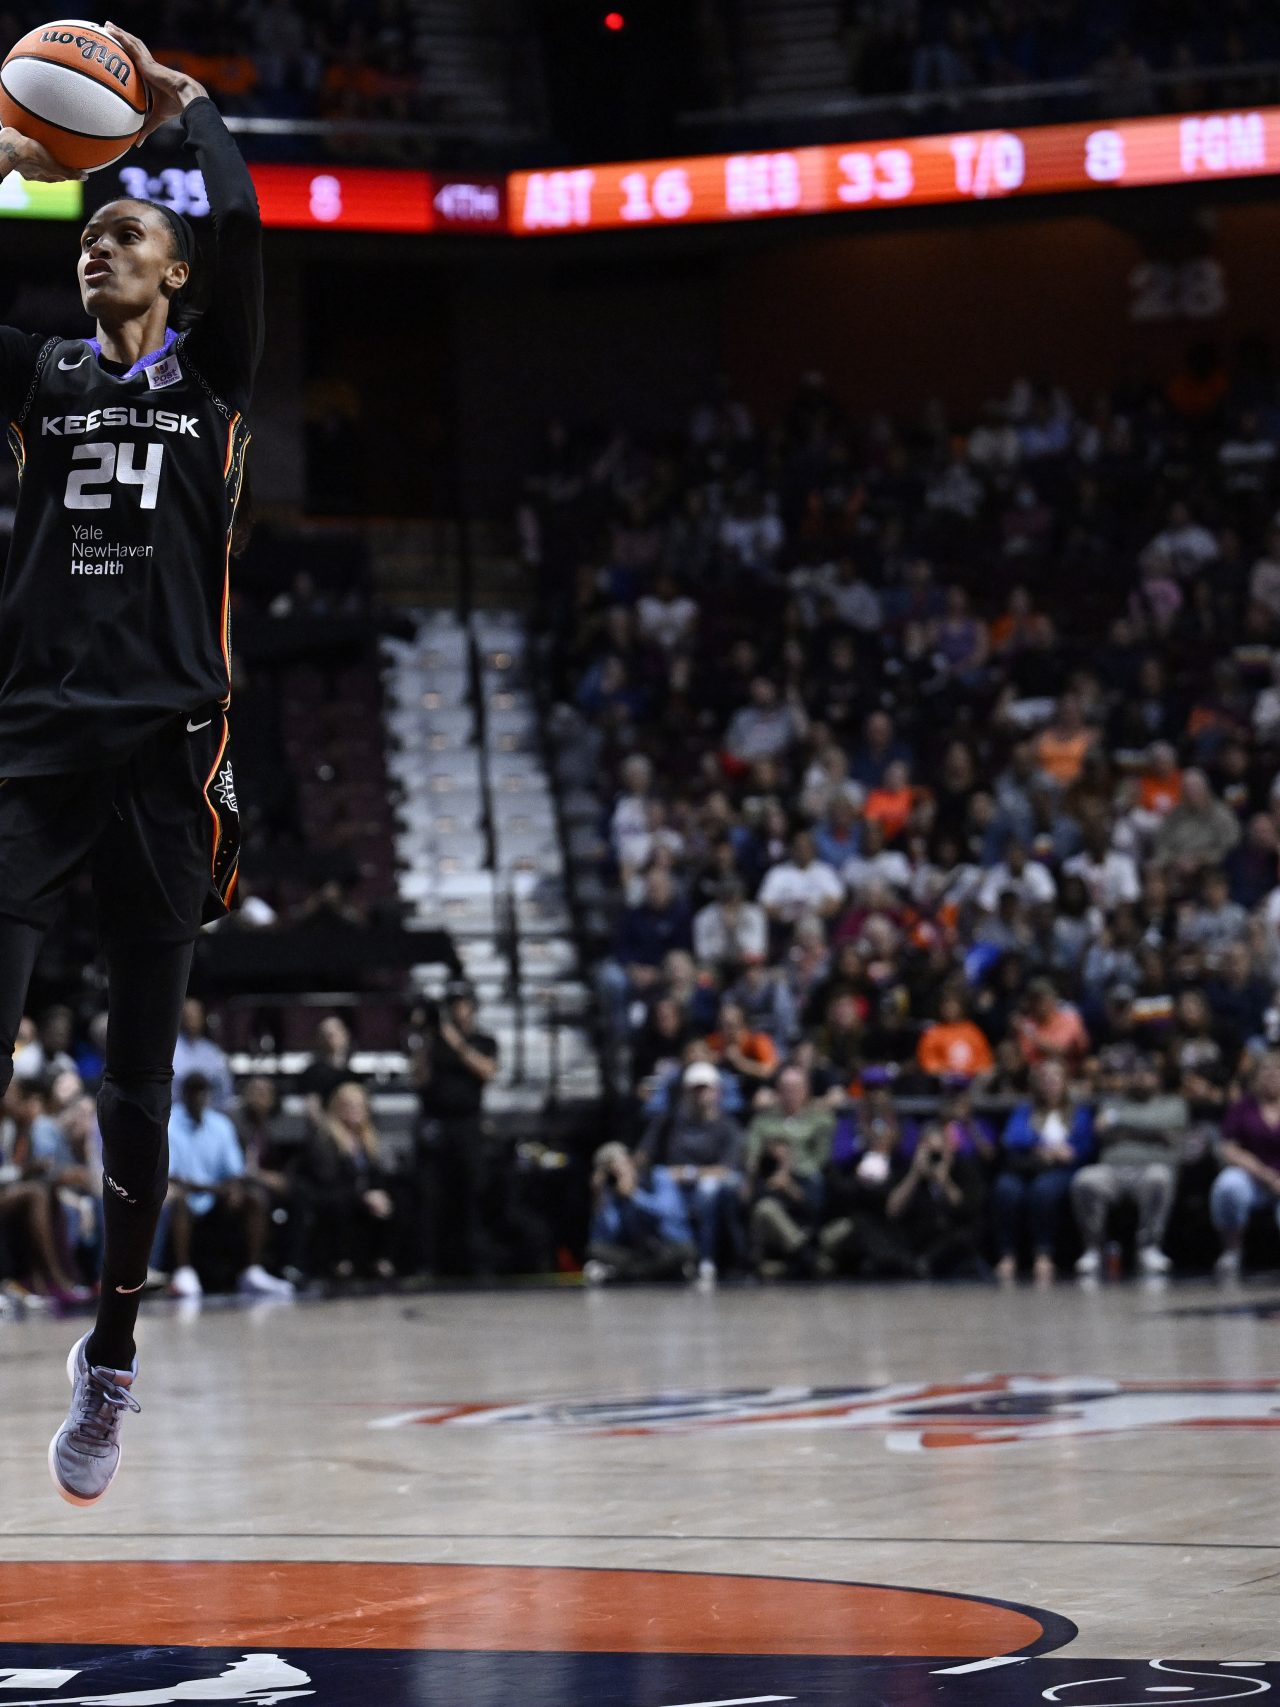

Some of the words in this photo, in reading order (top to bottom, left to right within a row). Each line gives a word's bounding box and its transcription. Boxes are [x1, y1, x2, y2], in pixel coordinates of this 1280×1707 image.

[40, 31, 131, 87] Wilson
[309, 174, 342, 223] 8
[523, 170, 595, 230] AST
[618, 168, 692, 223] 16
[837, 147, 913, 204] 33
[1128, 255, 1230, 322] 28
[41, 406, 200, 438] KEESUSK
[64, 443, 164, 509] 24
[71, 525, 103, 540] Yale
[71, 542, 154, 557] NewHaven
[71, 560, 124, 575] Health
